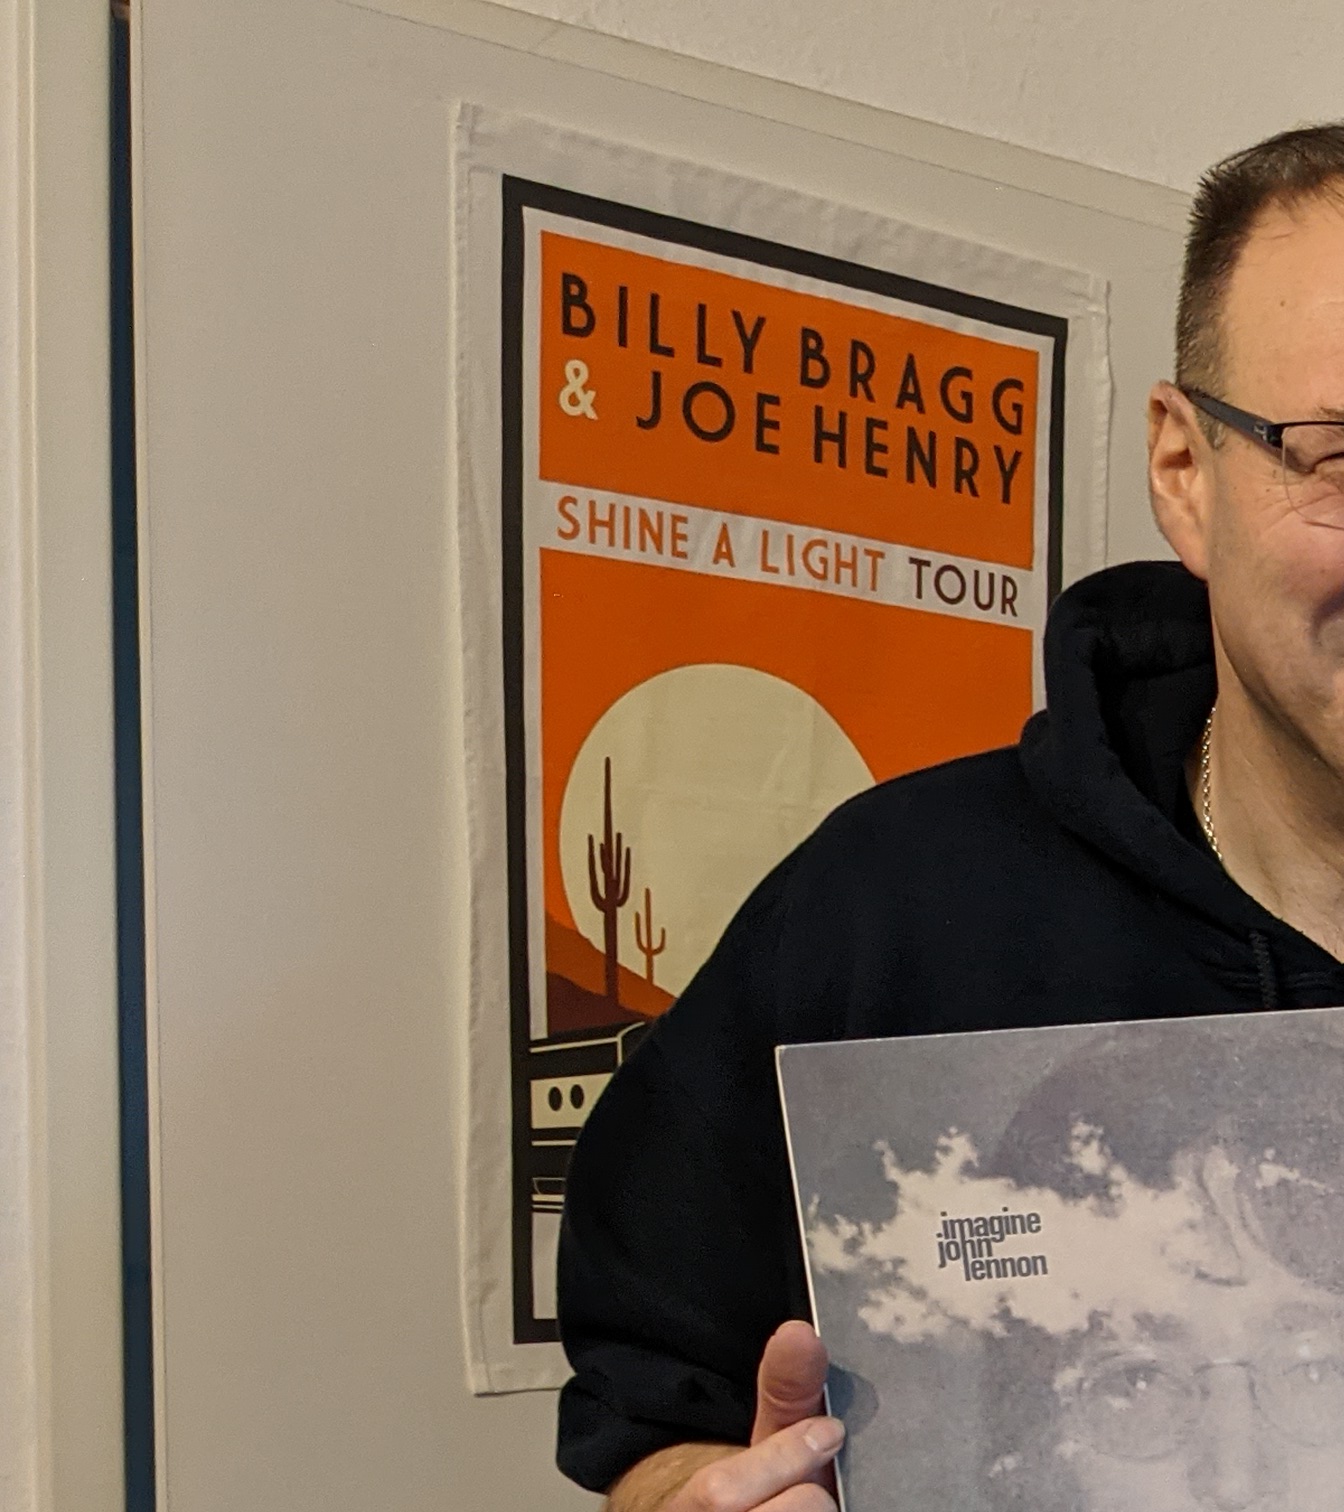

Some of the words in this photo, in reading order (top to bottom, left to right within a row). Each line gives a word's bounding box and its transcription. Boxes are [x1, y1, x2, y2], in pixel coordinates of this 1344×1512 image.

[560, 272, 766, 375] BILLY
[800, 327, 1025, 435] BRAGG
[558, 359, 598, 421] &
[636, 371, 781, 455] JOE
[813, 404, 1022, 505] HENRY
[555, 495, 689, 560] SHINE
[712, 522, 736, 568] A
[760, 529, 885, 592] LIGHT
[908, 556, 1019, 617] TOUR
[936, 1232, 993, 1269] john
[940, 1206, 1042, 1243] imagine
[964, 1252, 1049, 1282] lennon
